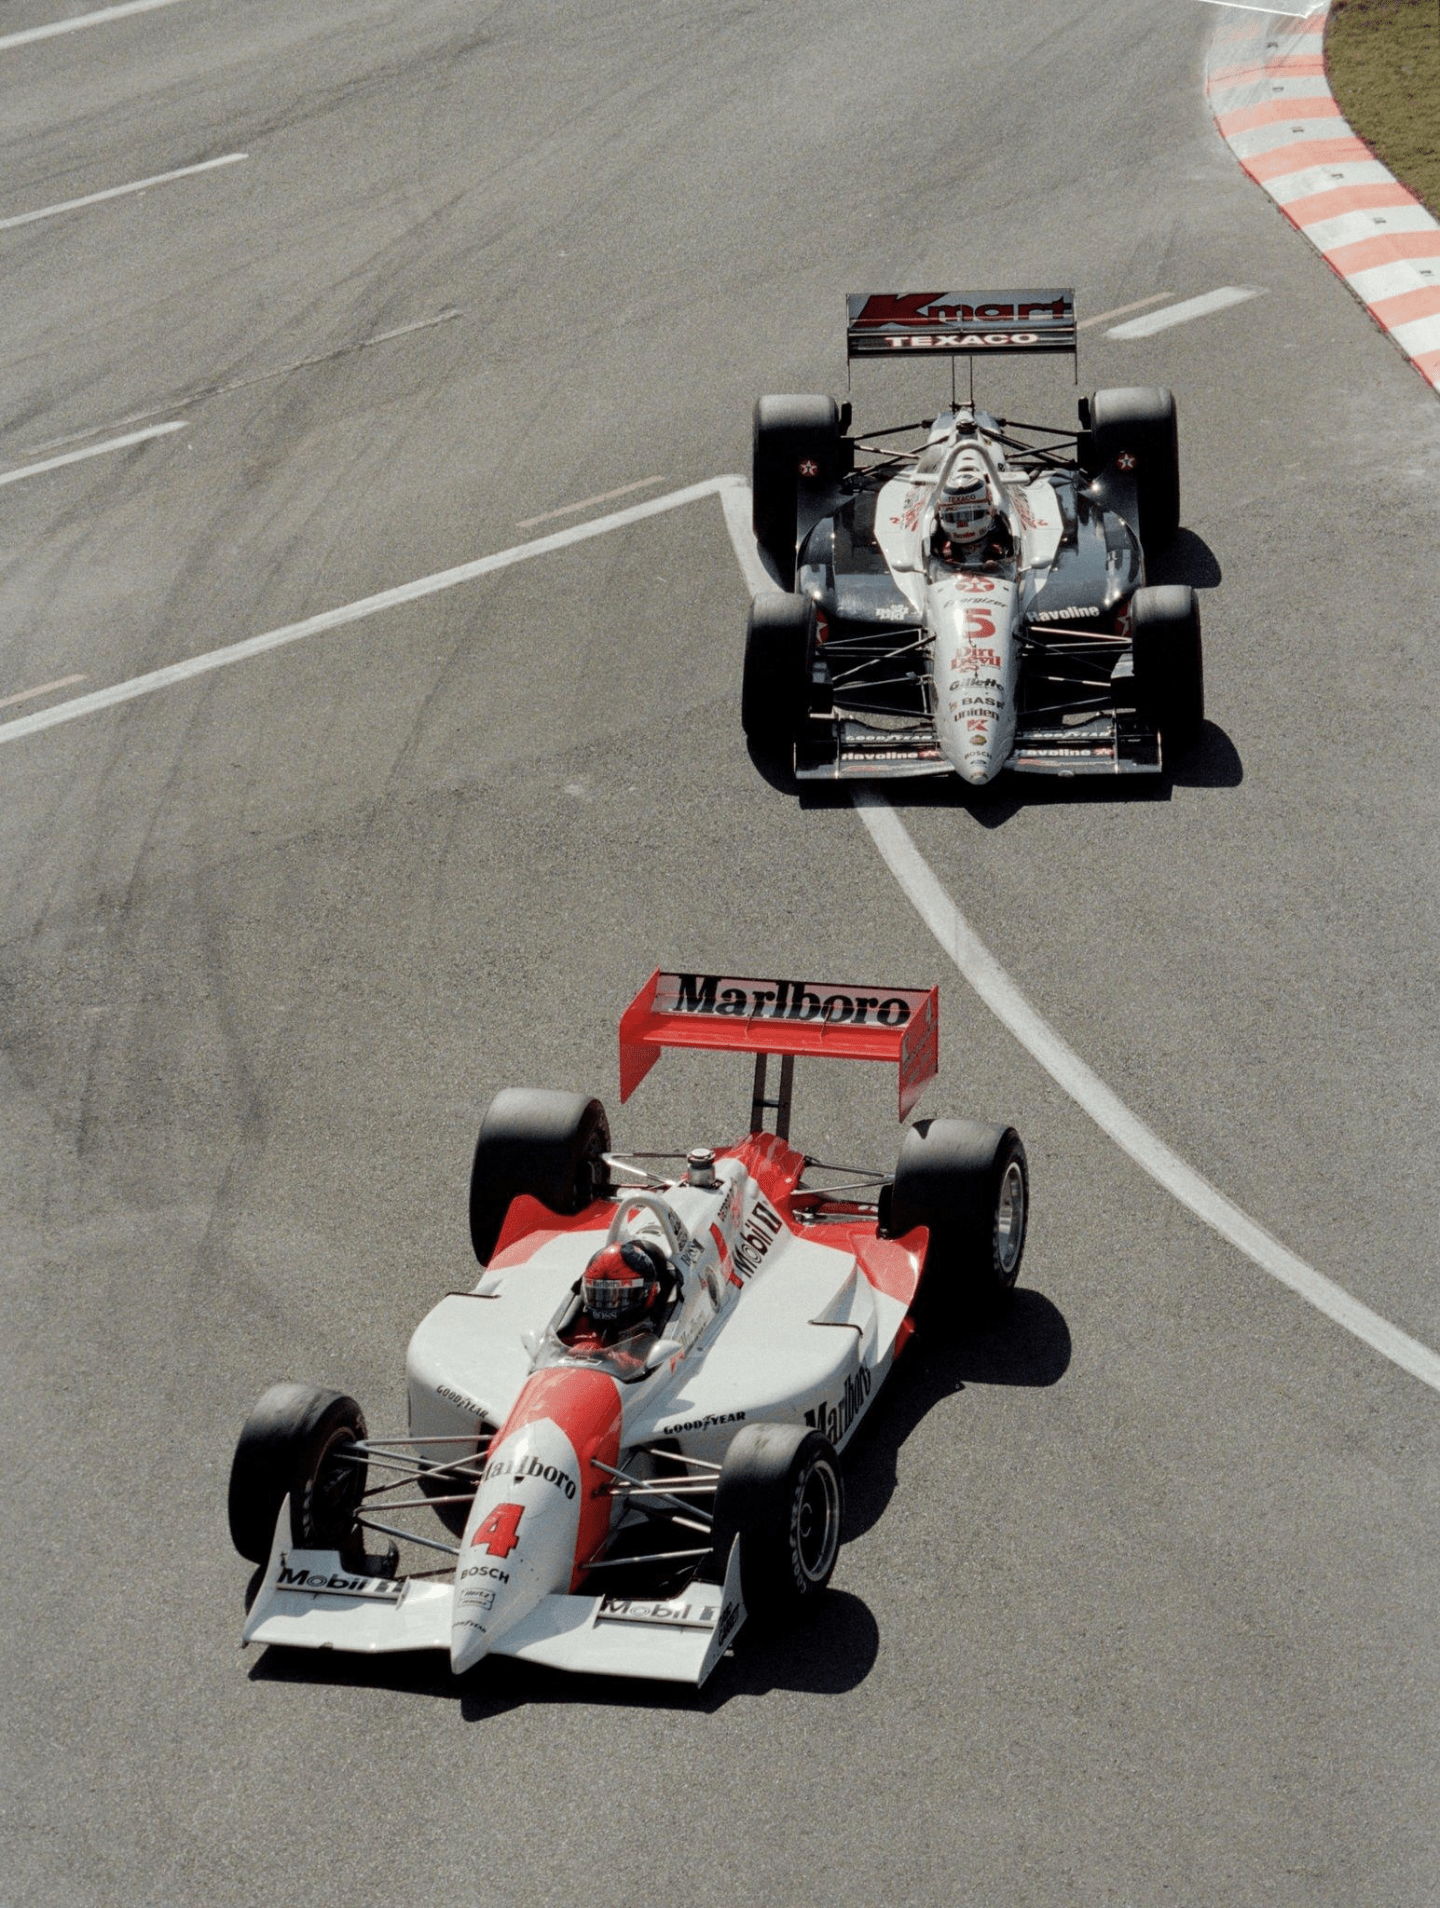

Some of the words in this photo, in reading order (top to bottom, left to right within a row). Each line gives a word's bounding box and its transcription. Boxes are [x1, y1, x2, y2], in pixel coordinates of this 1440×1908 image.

[850, 292, 1072, 328] Kmart
[885, 333, 1038, 347] TEXACO
[965, 608, 996, 639] 5
[1026, 606, 1100, 622] Havoline
[954, 708, 999, 722] uniden
[841, 751, 919, 760] Havoline
[672, 974, 911, 1026] Marlboro
[732, 1219, 774, 1279] Mobil
[436, 1384, 489, 1418] GOODYEAR
[804, 1365, 872, 1445] Marlboro
[664, 1411, 746, 1435] GOODYEAR
[471, 1502, 526, 1559] 4
[277, 1568, 369, 1590] Mobil
[460, 1566, 510, 1585] BOSCH
[600, 1600, 692, 1620] Mobil
